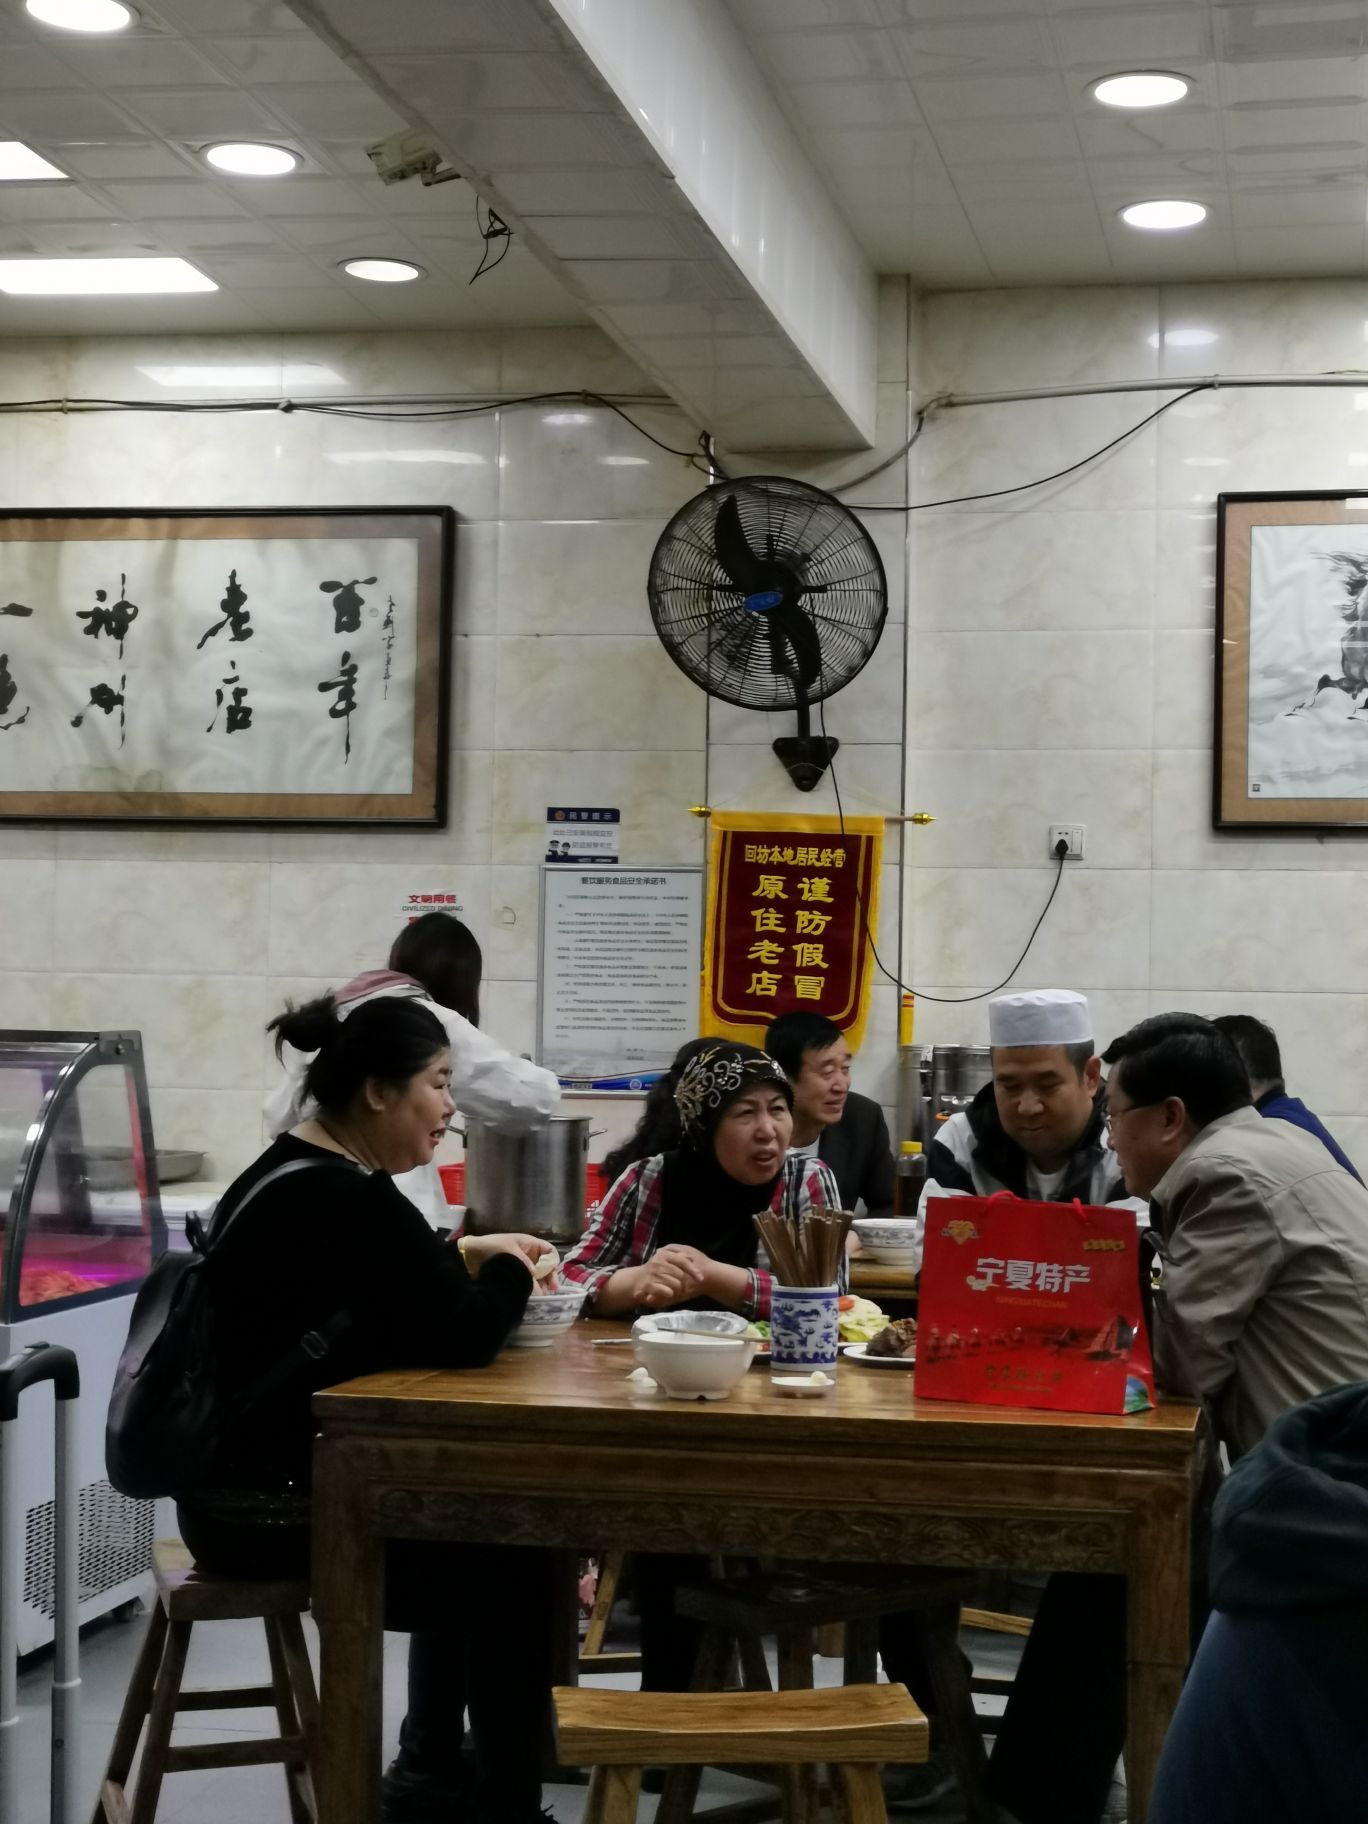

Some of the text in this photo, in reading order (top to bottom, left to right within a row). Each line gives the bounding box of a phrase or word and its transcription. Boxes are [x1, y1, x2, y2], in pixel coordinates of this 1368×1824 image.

[744, 844, 847, 868] 回坊本地居民经营
[407, 894, 457, 904] 文明用餐
[745, 874, 789, 997] 原住老店
[792, 876, 835, 1001] 谨防假冒
[974, 1257, 1092, 1294] 宁夏特产
